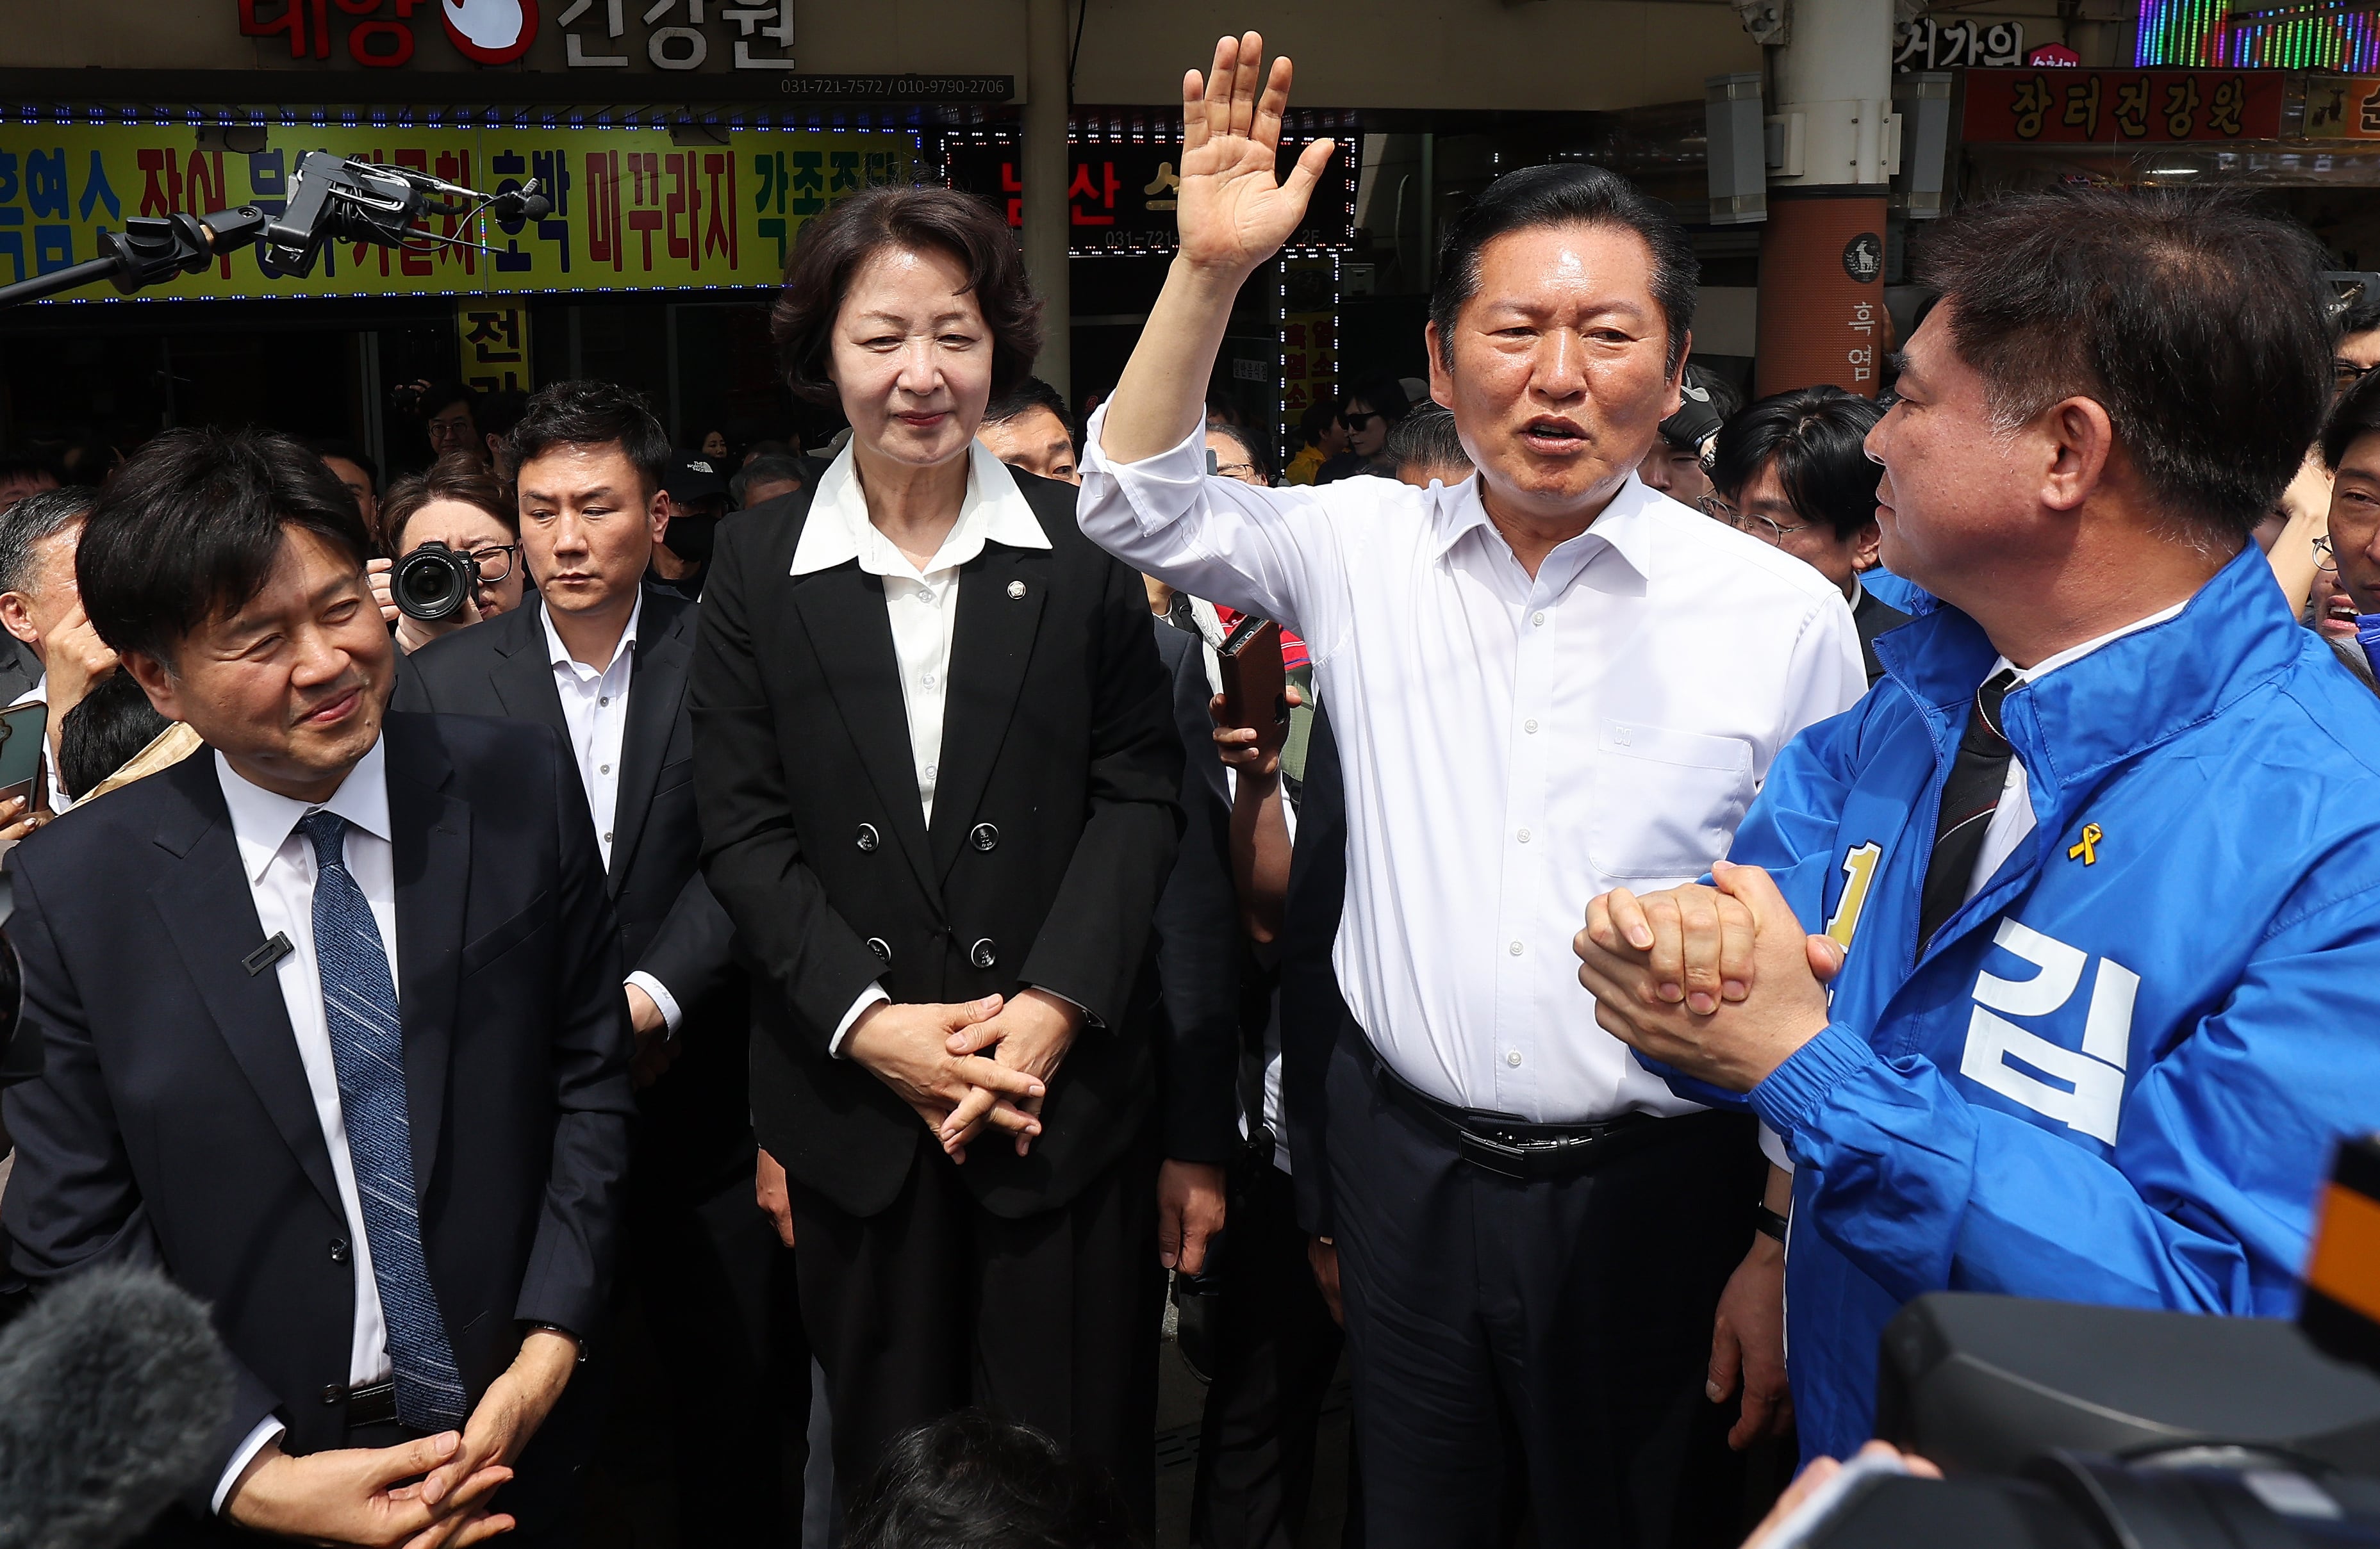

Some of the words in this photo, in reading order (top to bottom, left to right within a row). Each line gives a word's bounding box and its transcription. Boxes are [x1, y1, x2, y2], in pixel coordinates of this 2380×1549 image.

[781, 79, 884, 94] 031-721-7572
[897, 79, 1005, 94] 010-9790-2706
[586, 149, 738, 272] 미꾸라지
[1847, 301, 1876, 382] 흑염
[1826, 840, 1882, 955] 1
[1960, 915, 2141, 1147] 김
